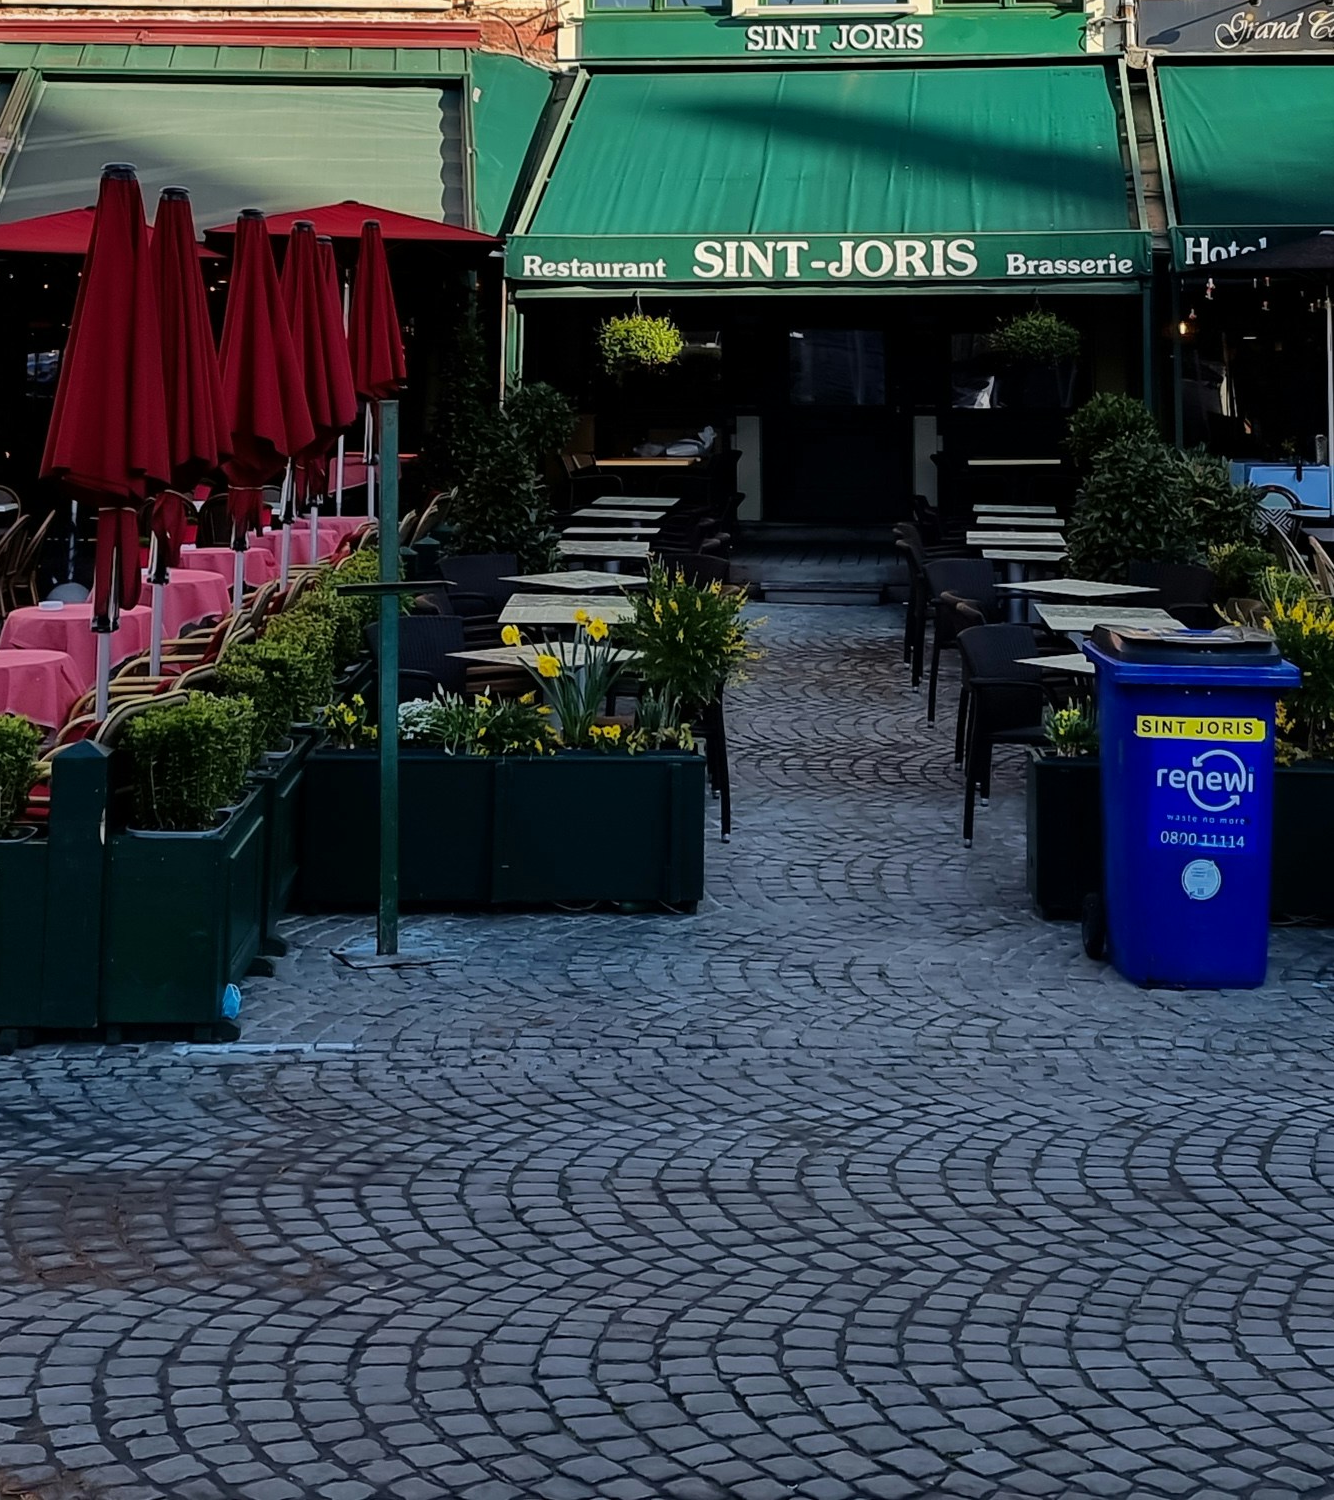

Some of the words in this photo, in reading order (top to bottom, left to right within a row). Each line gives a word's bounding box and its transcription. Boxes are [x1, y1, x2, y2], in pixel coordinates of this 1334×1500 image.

[746, 23, 817, 51] SINT
[831, 22, 924, 50] JORIS
[1214, 10, 1303, 49] Grand
[522, 254, 667, 278] Restaurant
[693, 239, 978, 278] SINT-JORIS
[1005, 253, 1134, 276] Brasserie
[1140, 719, 1186, 736] SINT
[1195, 720, 1255, 736] JORIS
[1156, 766, 1255, 794] renewi
[1219, 817, 1246, 825] more
[1160, 830, 1197, 846] 0800
